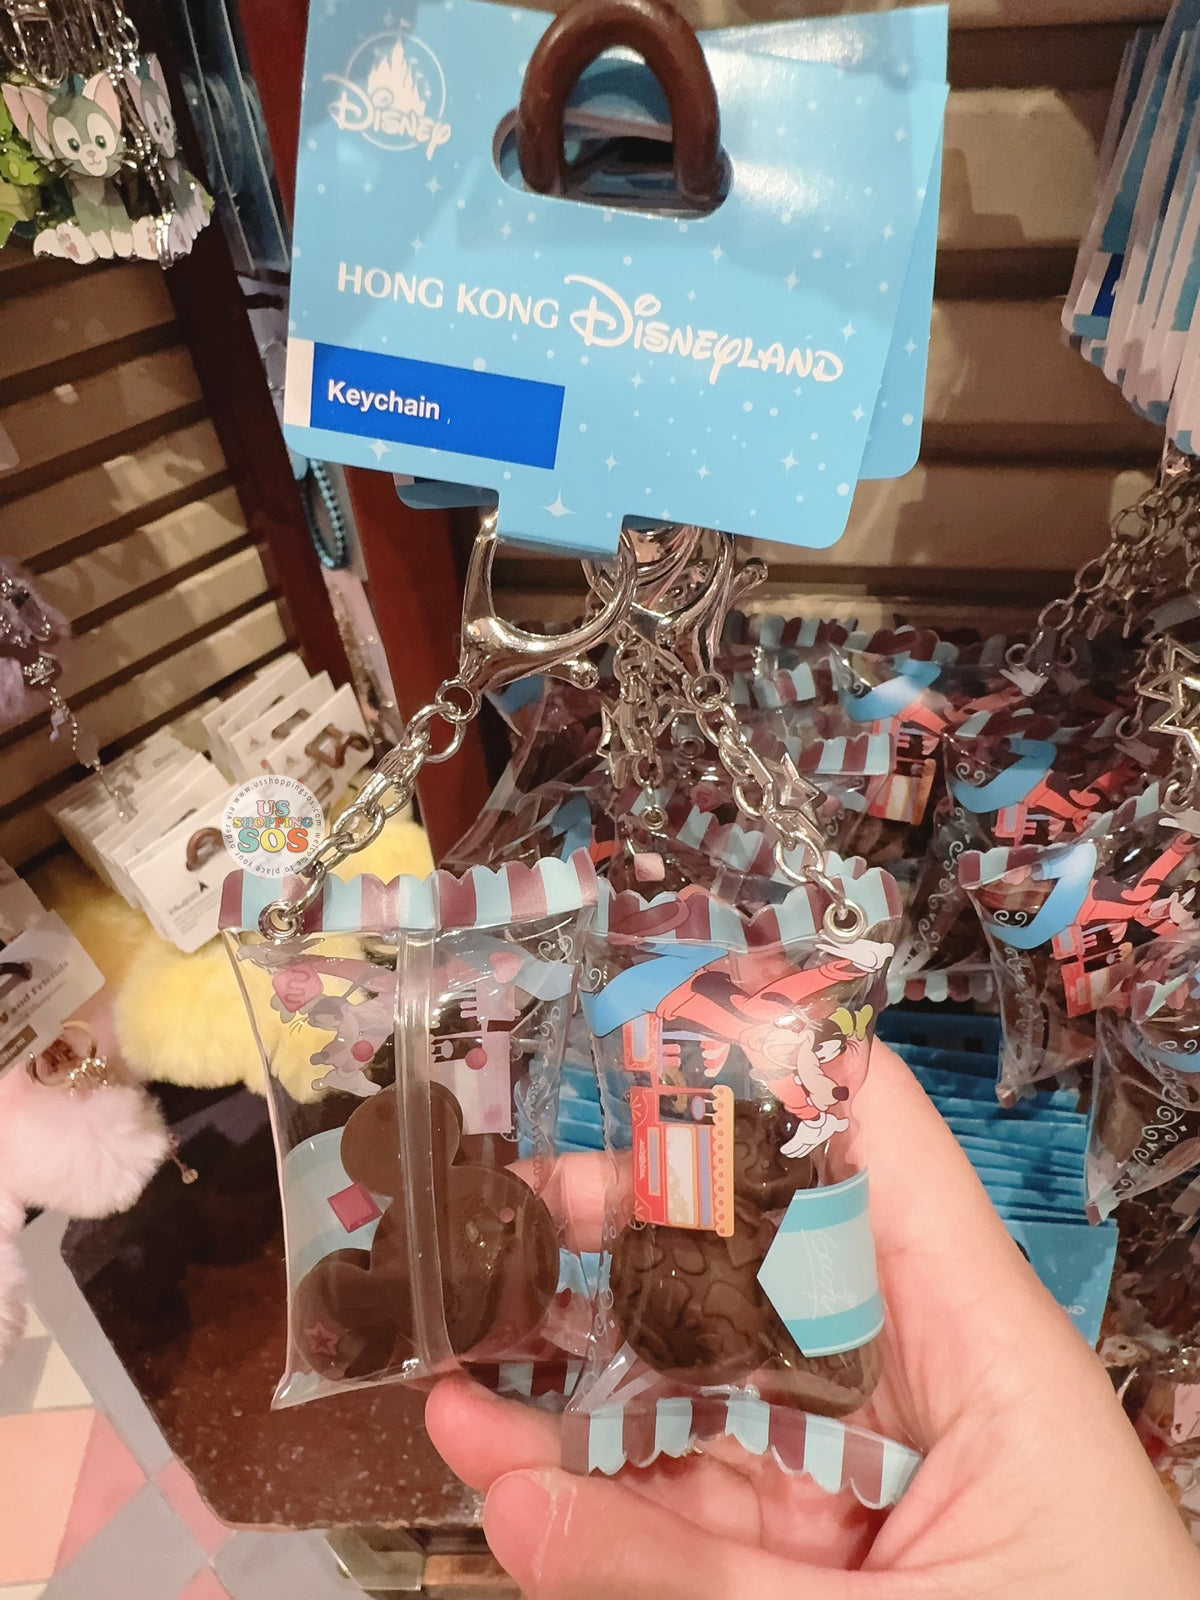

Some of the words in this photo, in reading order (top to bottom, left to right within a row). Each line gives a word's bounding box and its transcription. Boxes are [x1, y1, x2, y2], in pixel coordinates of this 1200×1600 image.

[323, 73, 451, 161] Disney
[338, 262, 444, 309] HONG
[456, 283, 560, 329] KONG
[328, 379, 440, 421] Keychain
